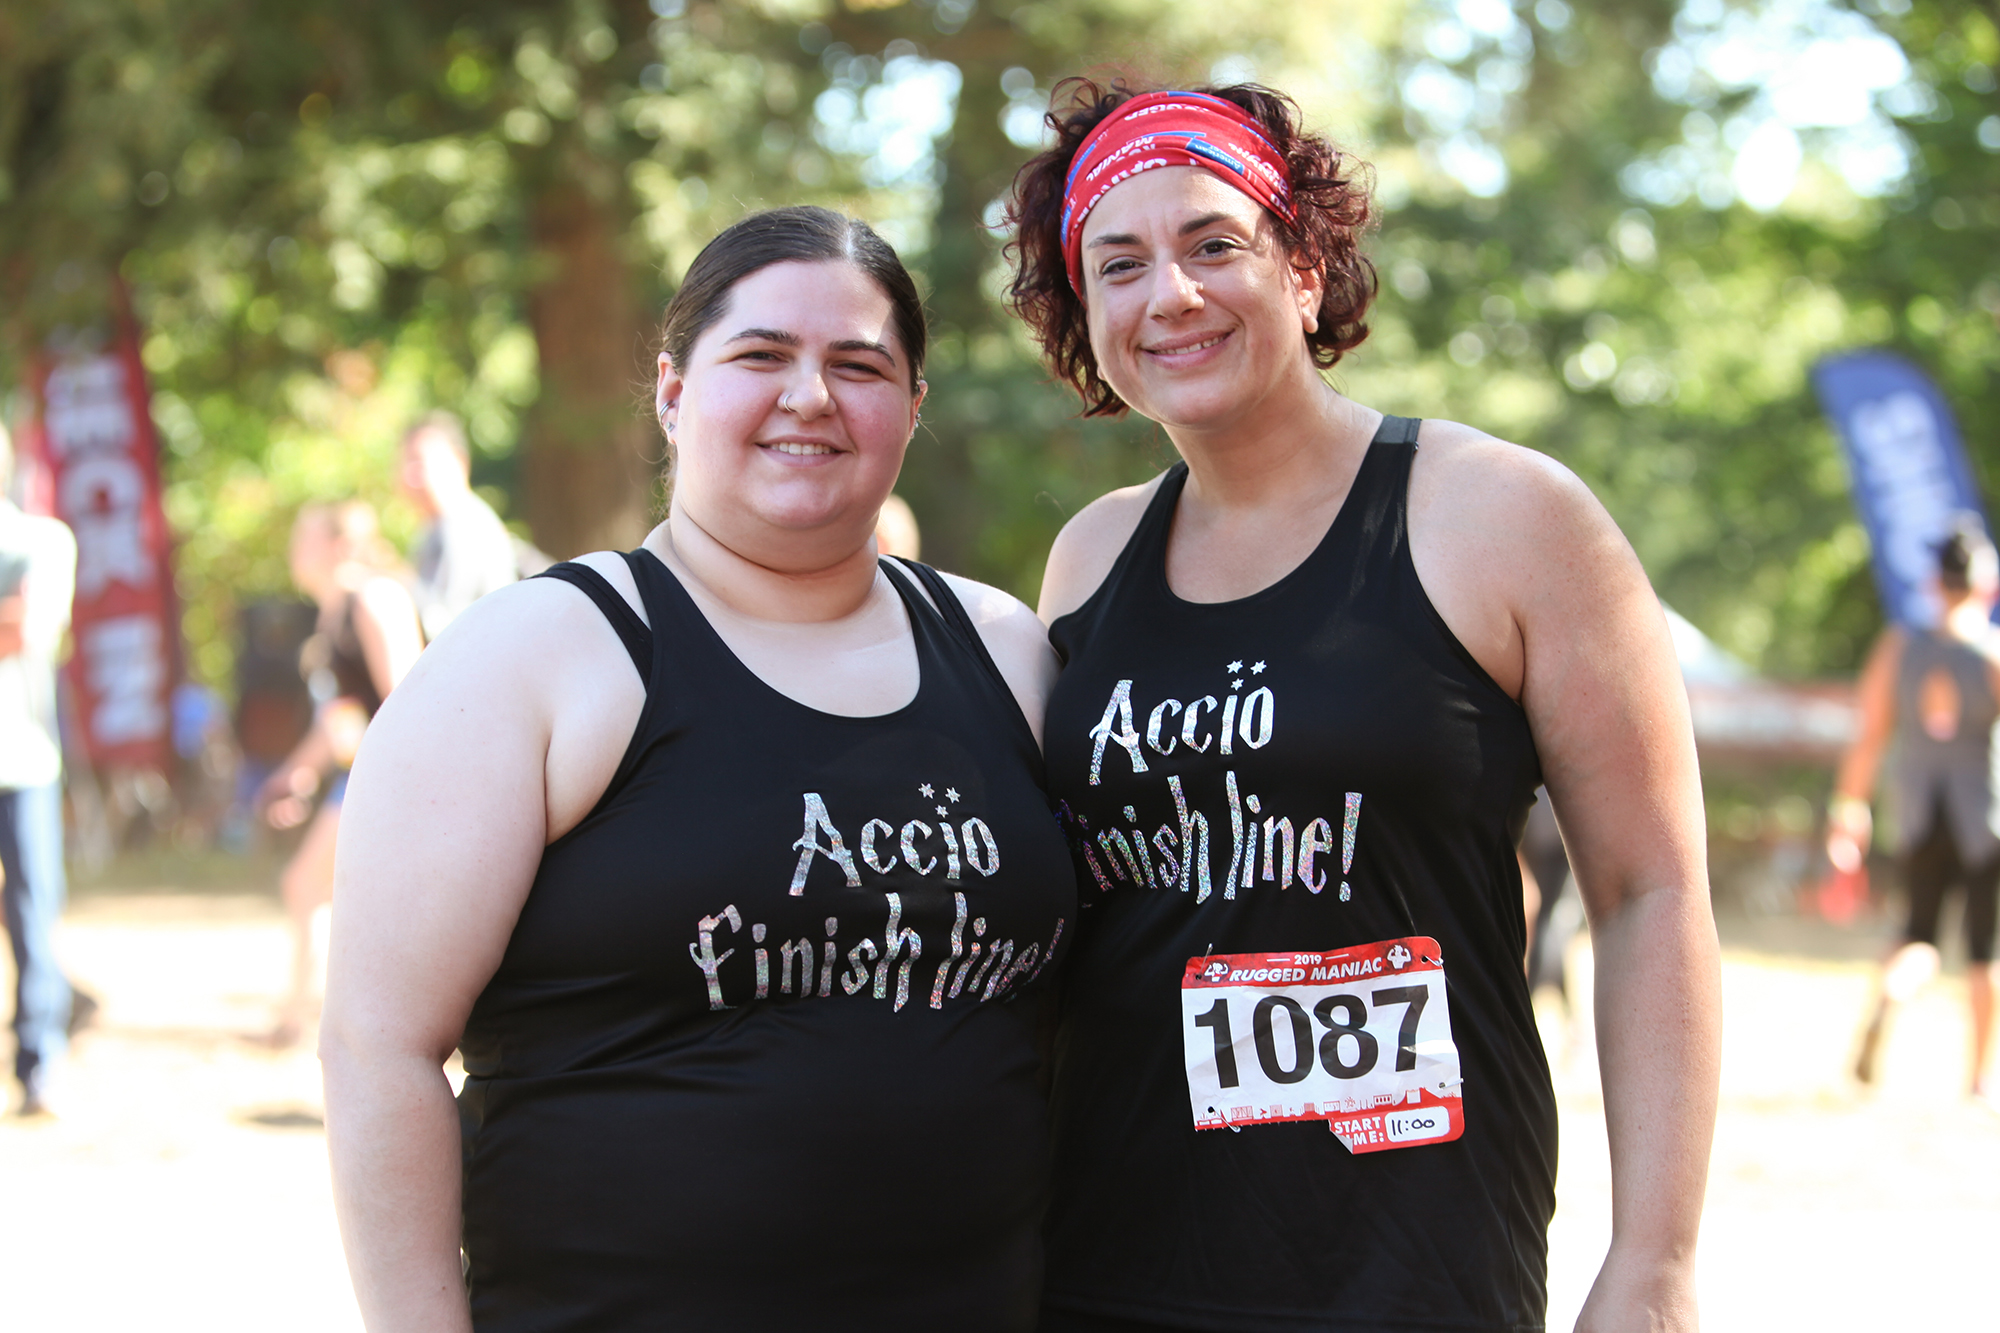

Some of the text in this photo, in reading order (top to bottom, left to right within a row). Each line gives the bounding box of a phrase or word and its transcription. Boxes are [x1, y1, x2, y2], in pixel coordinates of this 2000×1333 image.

[1089, 678, 1275, 786] Accio
[788, 792, 1000, 896] Accio
[1223, 770, 1363, 903] line!
[1228, 956, 1382, 983] RUGGED MANIAC
[1293, 954, 1322, 966] 2019
[1194, 984, 1430, 1089] 1087
[1334, 1116, 1382, 1135] START
[1391, 1118, 1436, 1136] 11:00
